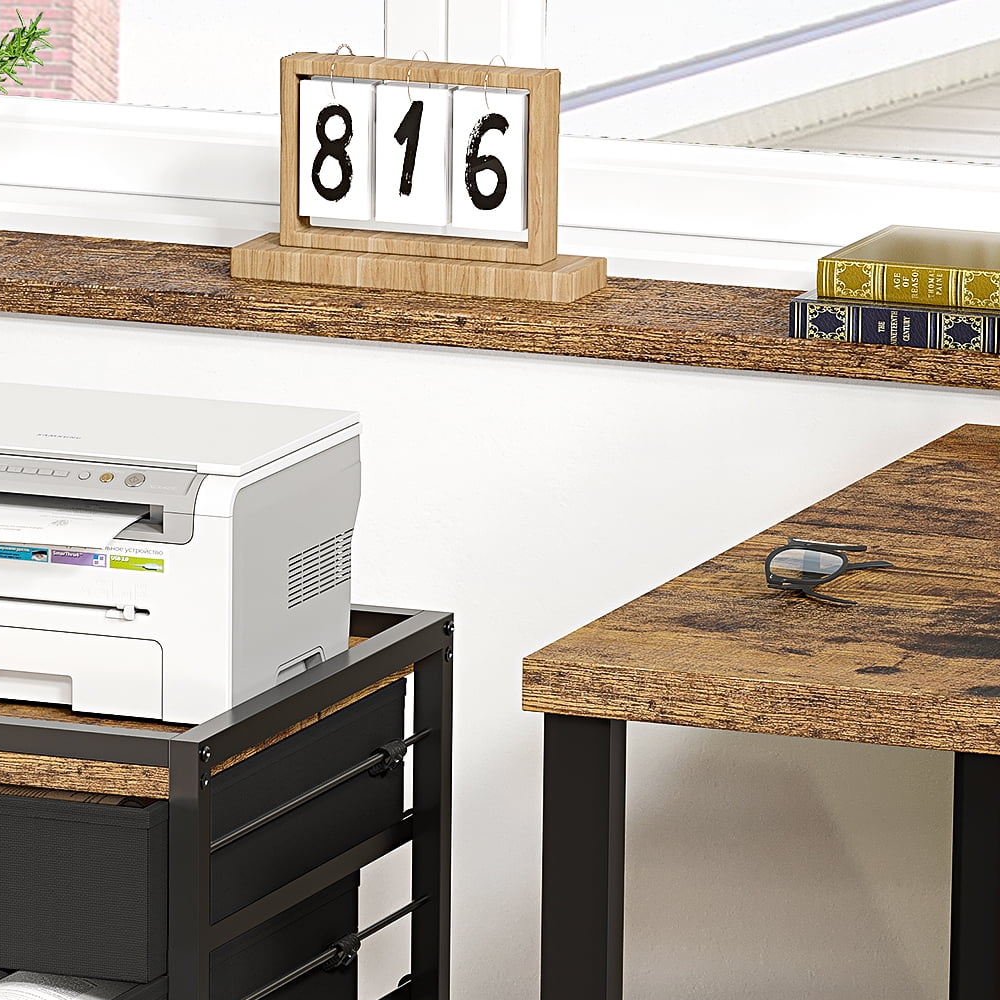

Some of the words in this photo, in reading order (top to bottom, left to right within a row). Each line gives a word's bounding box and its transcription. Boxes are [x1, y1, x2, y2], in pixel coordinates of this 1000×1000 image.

[311, 103, 353, 202] 8
[393, 100, 424, 197] 1
[465, 112, 510, 211] 6
[893, 272, 901, 290] AGE
[902, 276, 910, 288] OF
[877, 321, 885, 333] THE
[902, 316, 911, 342] CENTURY
